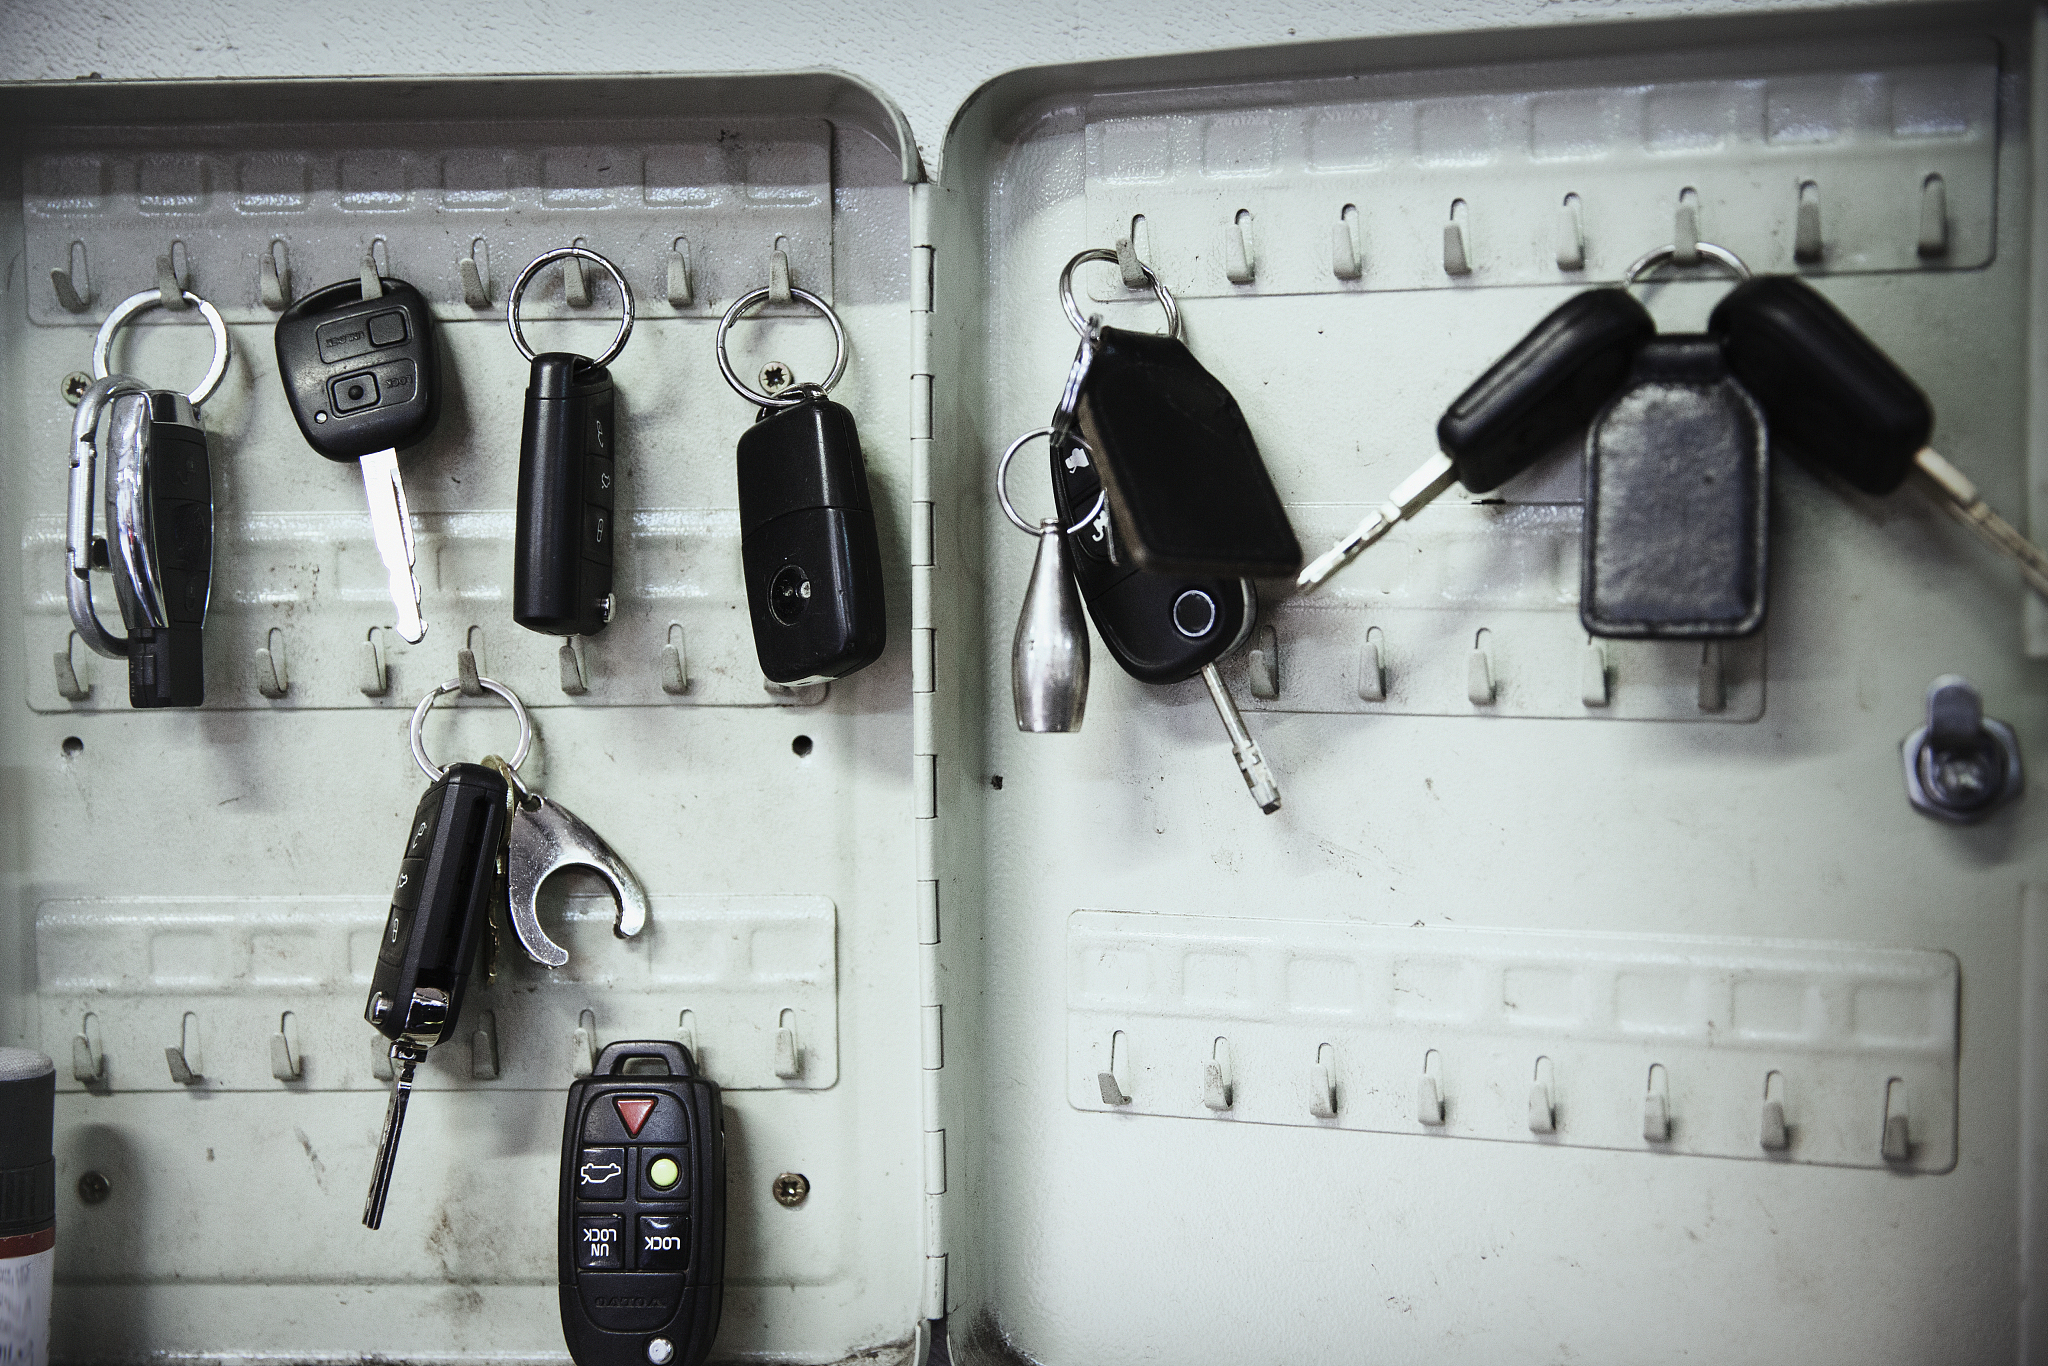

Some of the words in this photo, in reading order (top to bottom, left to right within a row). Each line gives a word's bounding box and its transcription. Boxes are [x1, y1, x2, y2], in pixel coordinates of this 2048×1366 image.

[325, 331, 365, 348] UNLOCK
[386, 375, 413, 389] LOCK
[583, 1228, 617, 1242] LOCK
[591, 1243, 609, 1257] UN
[645, 1236, 681, 1250] LOCK
[595, 1297, 667, 1308] VOLVO
